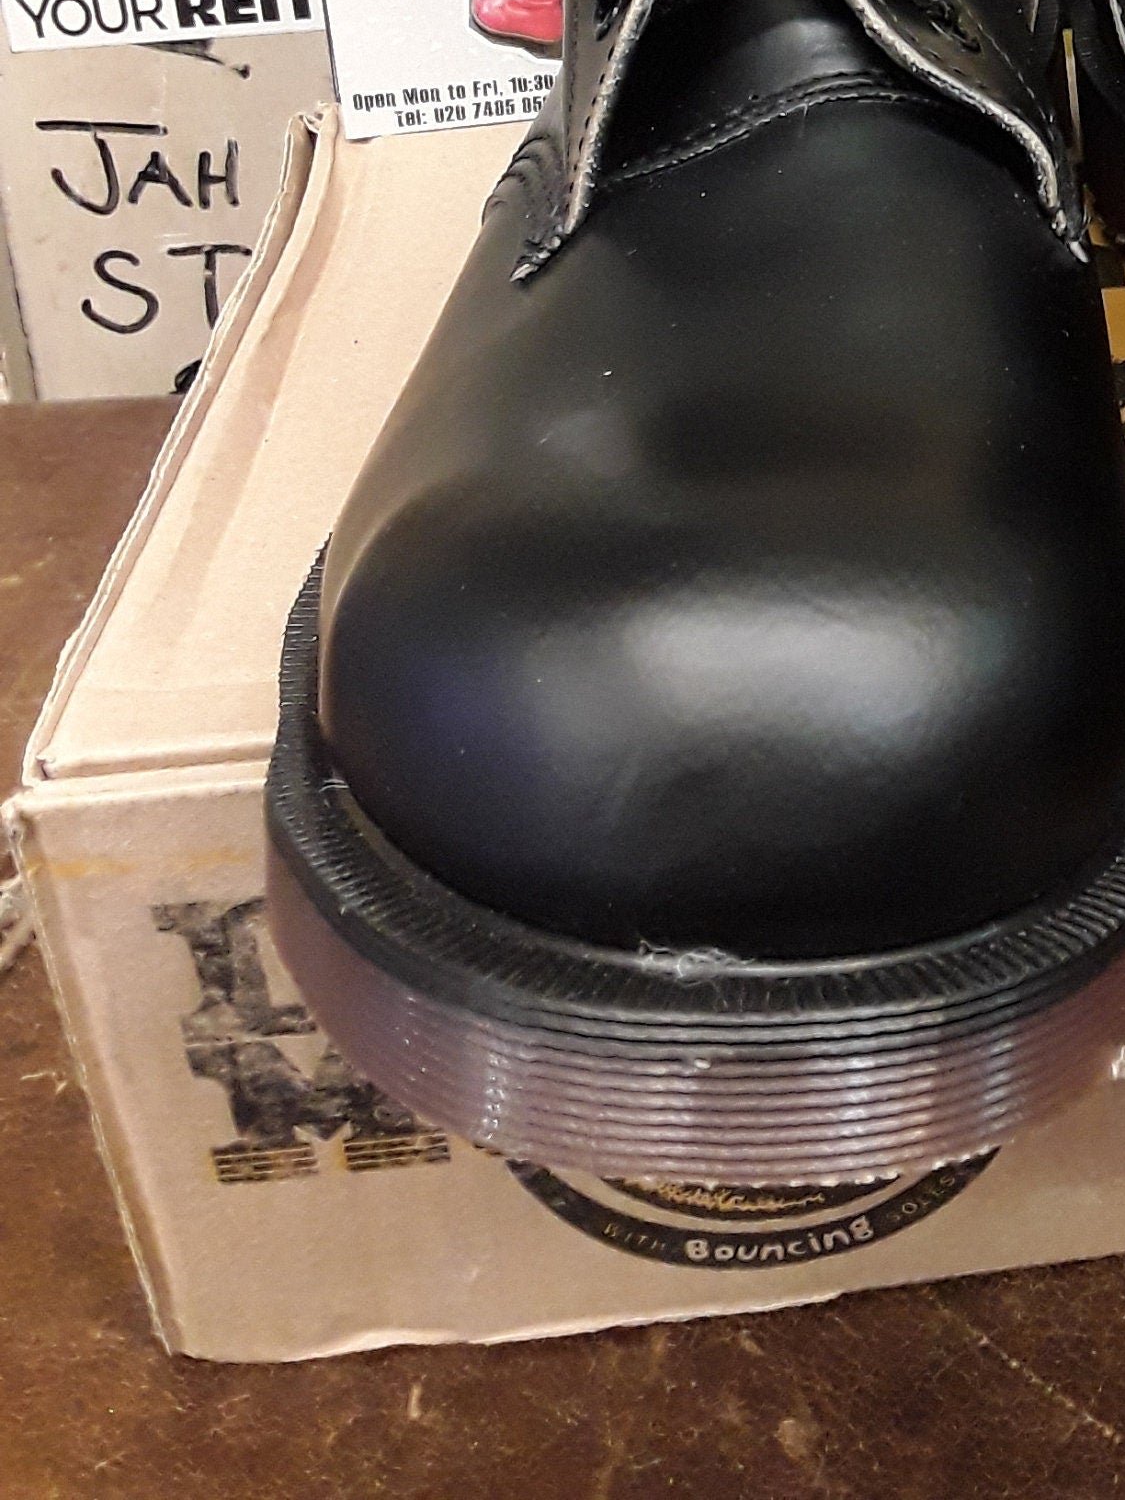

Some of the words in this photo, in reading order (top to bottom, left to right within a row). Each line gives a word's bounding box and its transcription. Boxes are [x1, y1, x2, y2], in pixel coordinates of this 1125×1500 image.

[352, 93, 397, 113] Open
[402, 87, 441, 106] Mon
[448, 83, 466, 100] to
[394, 110, 427, 128] Tel:
[35, 119, 242, 216] JAH
[683, 1215, 875, 1264] Bouncing
